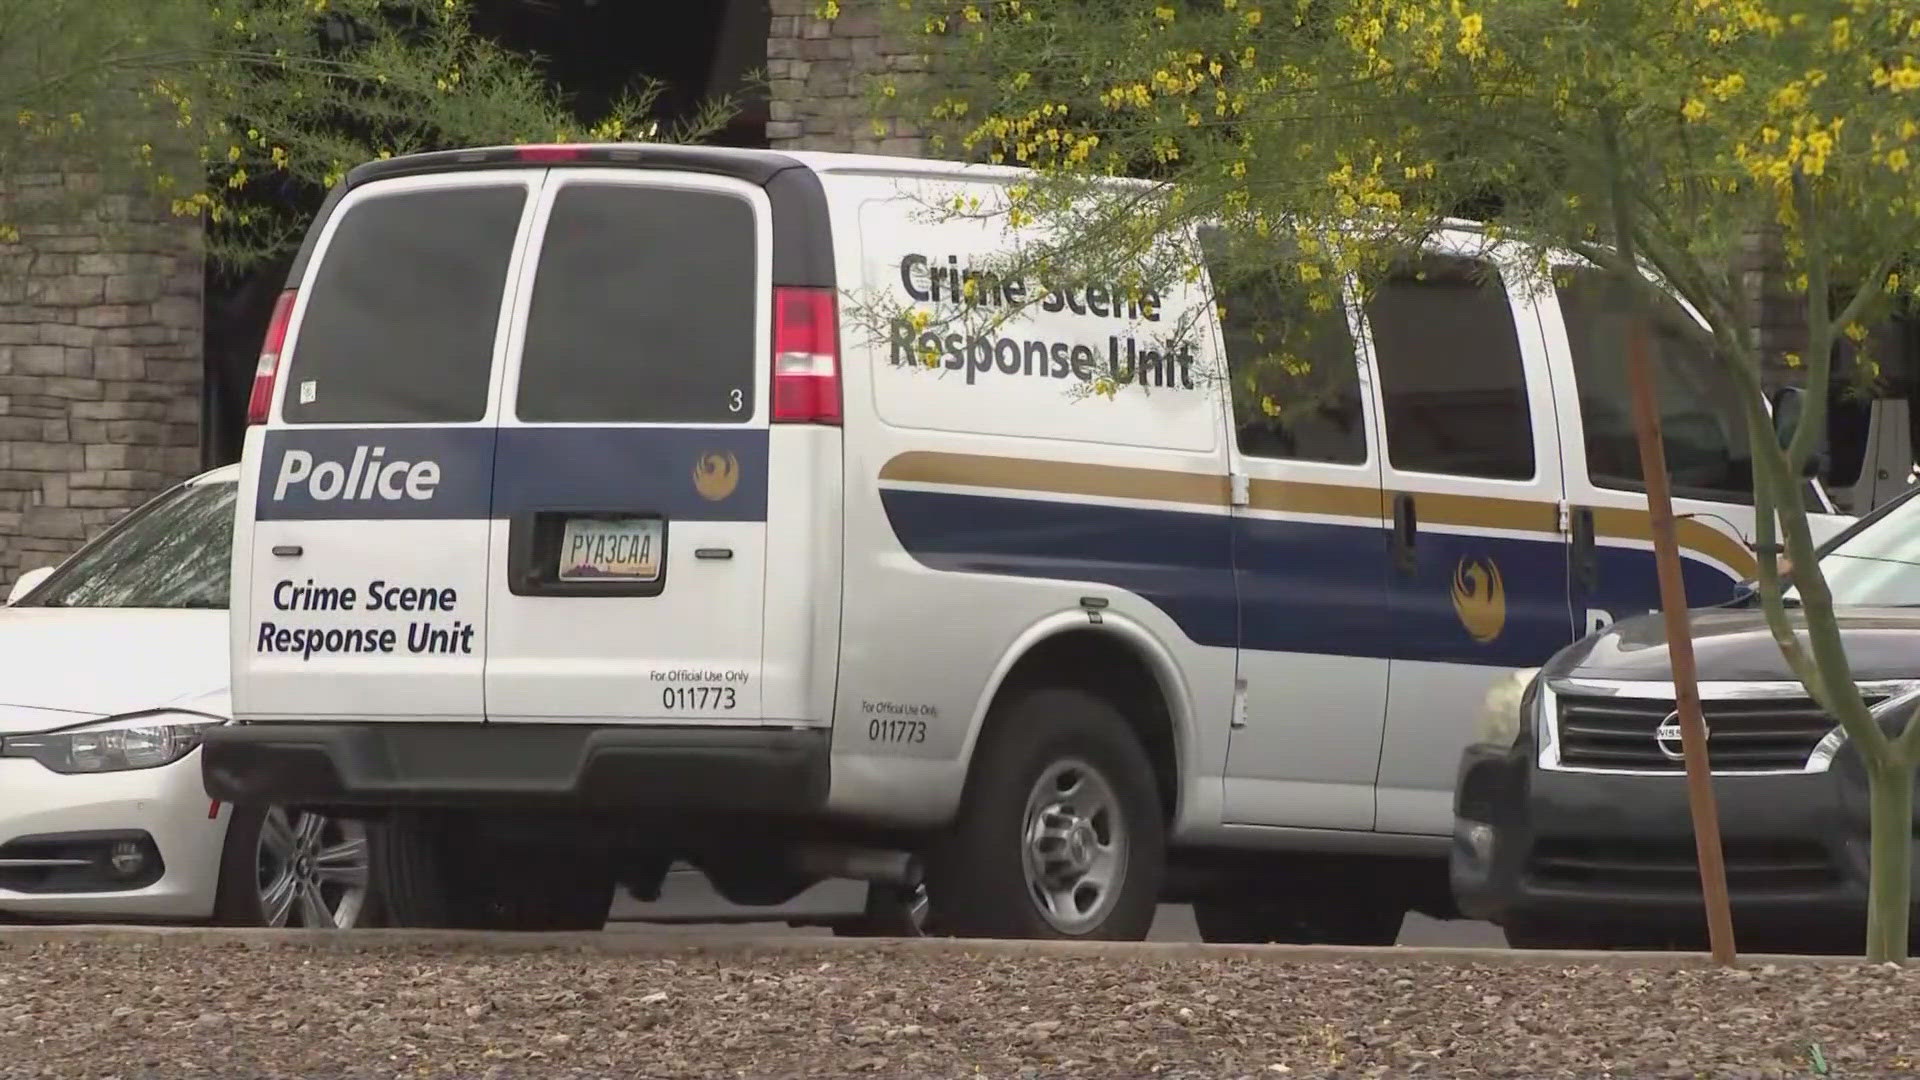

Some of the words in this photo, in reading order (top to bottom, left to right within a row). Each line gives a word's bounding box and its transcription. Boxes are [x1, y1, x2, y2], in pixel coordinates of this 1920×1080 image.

[900, 253, 1026, 305] Crime
[890, 318, 1094, 385] Response
[1109, 336, 1195, 390] Unit
[729, 389, 742, 411] 3
[273, 447, 440, 501] Police
[570, 534, 651, 564] PYA3CAA
[273, 579, 356, 611] Crime
[366, 580, 456, 611] Scene
[257, 621, 396, 661] Response
[407, 621, 474, 653] Unit
[650, 670, 666, 682] For
[668, 670, 702, 682] Official
[705, 671, 723, 682] Use
[725, 671, 749, 684] Only
[663, 687, 736, 710] 011773
[869, 719, 926, 743] 011773
